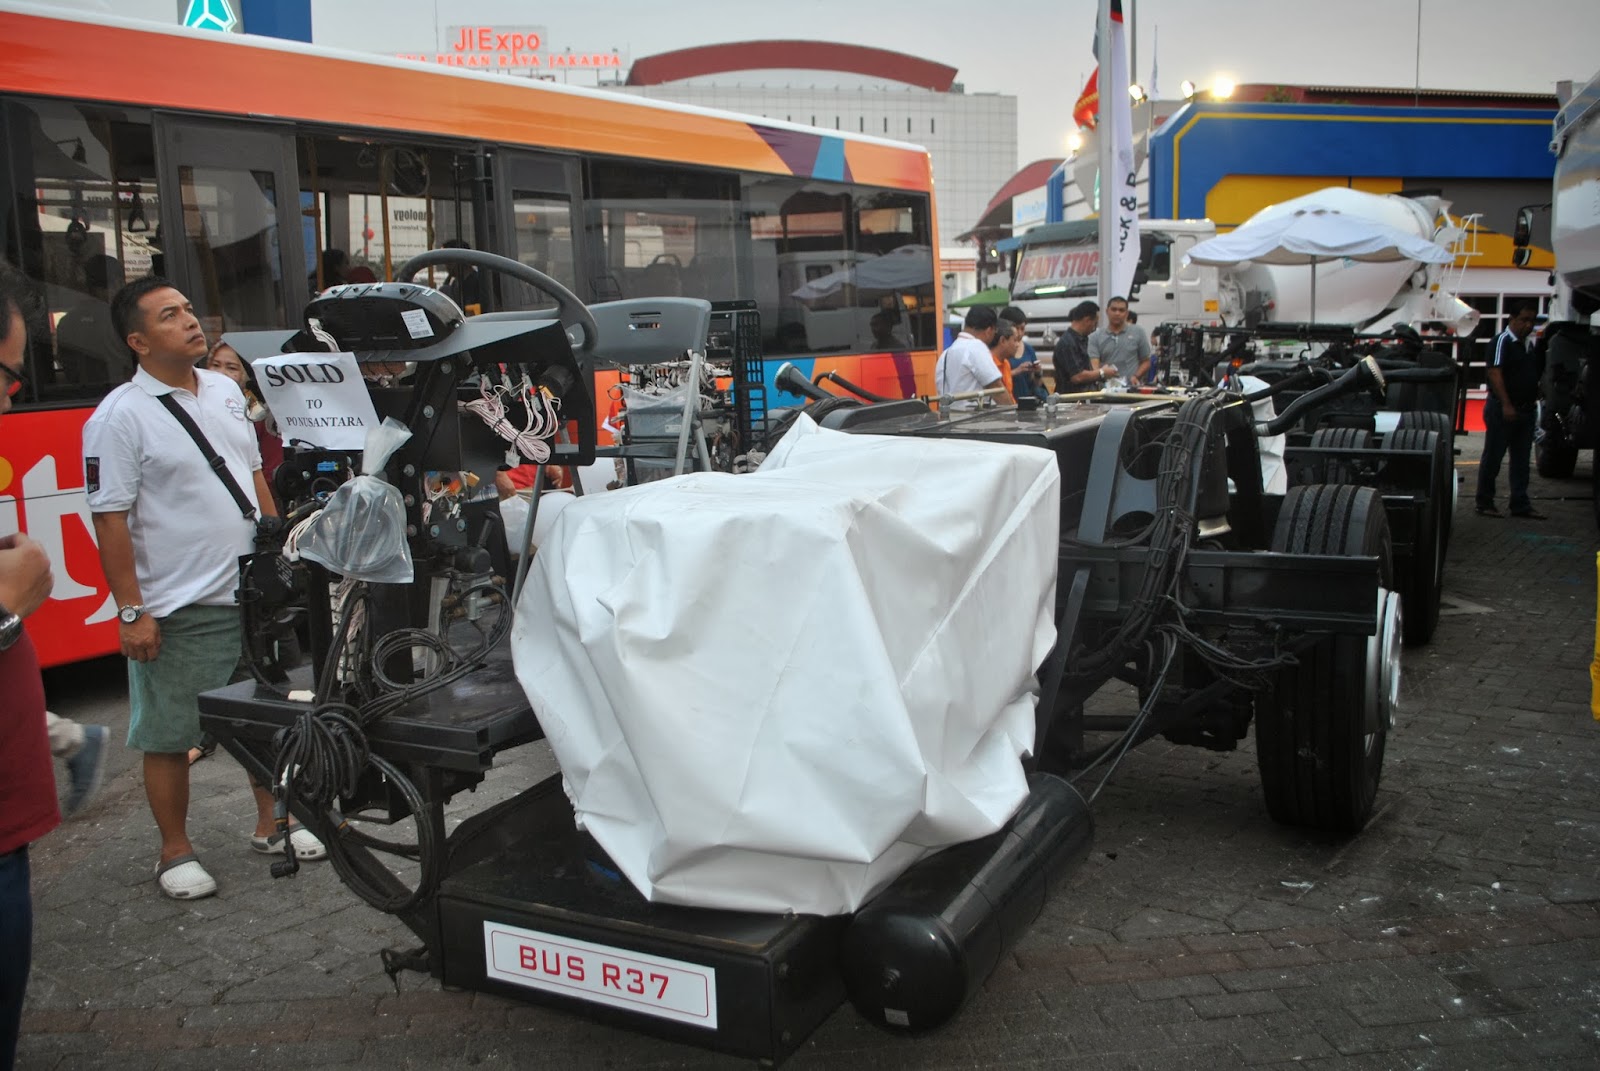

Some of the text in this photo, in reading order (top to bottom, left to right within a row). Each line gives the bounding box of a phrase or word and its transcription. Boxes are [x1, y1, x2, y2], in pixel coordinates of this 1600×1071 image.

[454, 27, 541, 57] JIExpo
[437, 54, 491, 67] PEKAN
[498, 53, 542, 67] RAYA
[549, 53, 622, 69] JAKARTA
[1019, 251, 1099, 282] READY STOC
[265, 363, 345, 387] SOLD
[306, 399, 323, 409] TO
[286, 416, 364, 427] PO NUSANTARA
[519, 944, 669, 999] BUS R37
